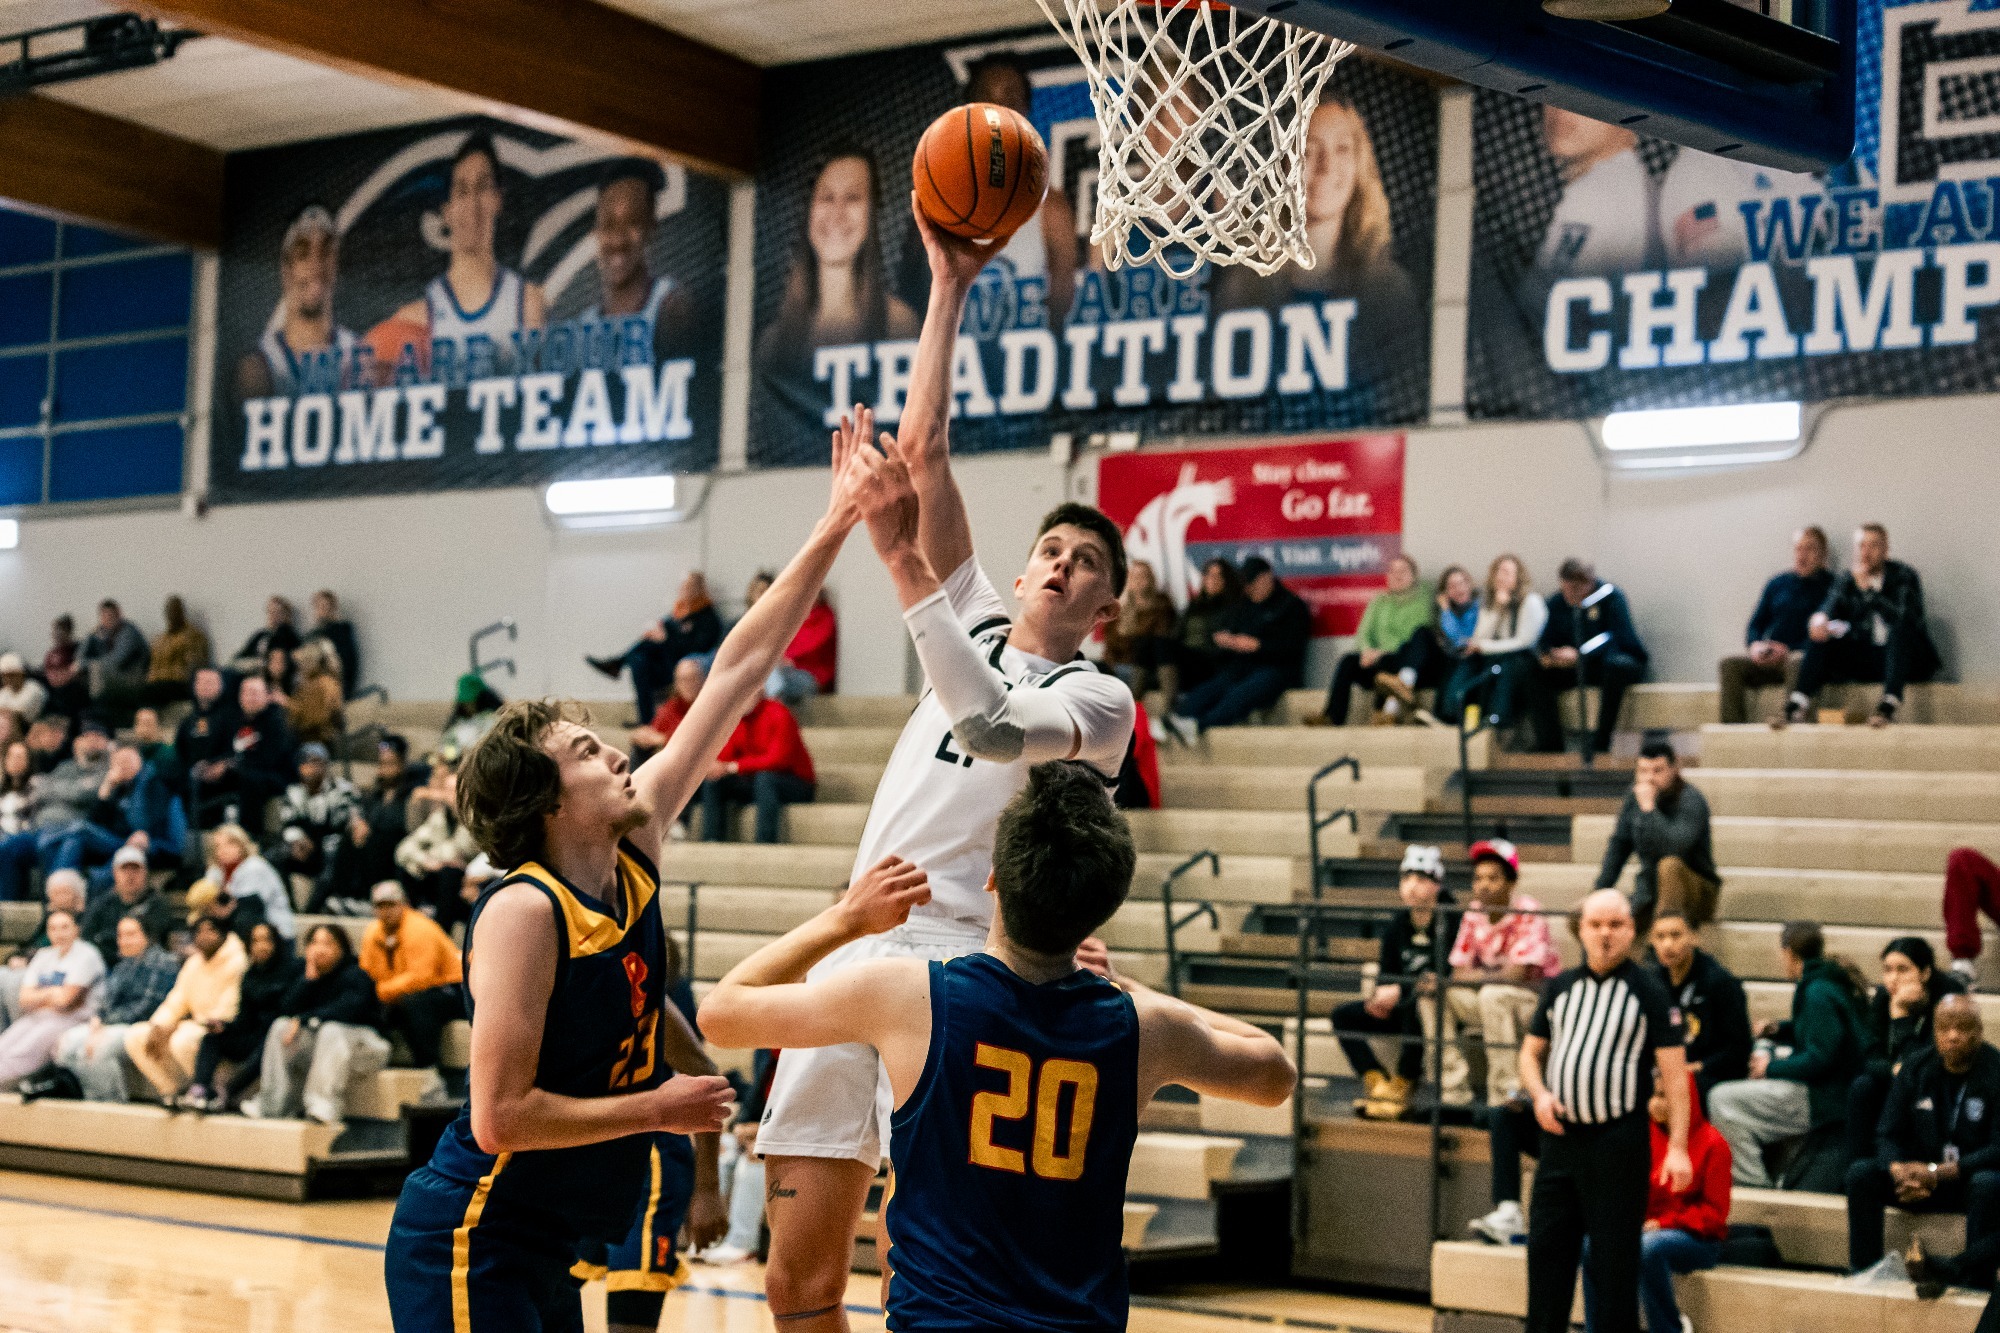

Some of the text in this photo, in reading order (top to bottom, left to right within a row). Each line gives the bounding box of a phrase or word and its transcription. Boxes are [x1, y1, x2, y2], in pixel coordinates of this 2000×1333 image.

[1738, 190, 1880, 262] WE
[1066, 258, 1209, 324] ARE
[298, 317, 653, 396] WE ARE YOUR
[814, 300, 1357, 428] TRADITION
[240, 358, 697, 471] HOME TEAM
[1281, 488, 1324, 521] Go
[608, 1008, 660, 1090] 23
[968, 1040, 1098, 1181] 20
